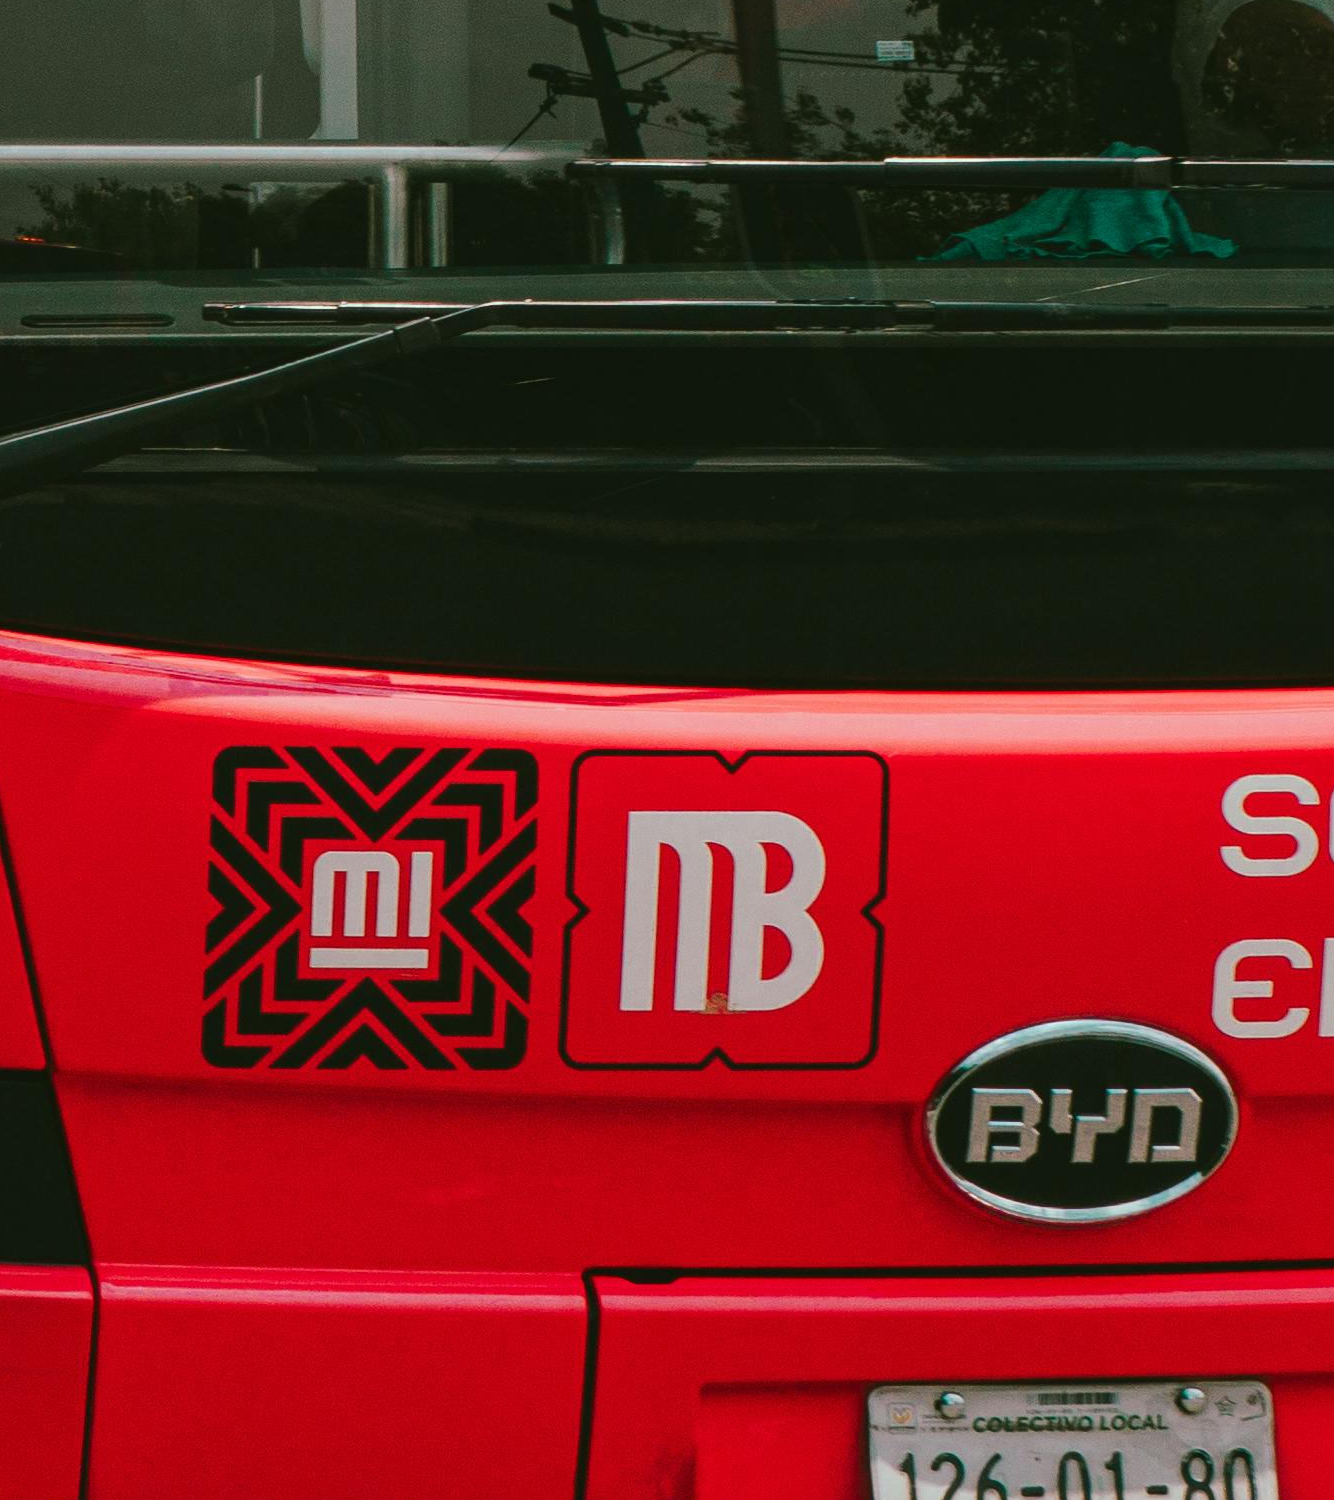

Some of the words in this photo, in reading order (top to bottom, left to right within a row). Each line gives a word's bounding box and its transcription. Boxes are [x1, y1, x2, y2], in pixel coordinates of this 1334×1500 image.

[619, 810, 827, 1012] MB
[964, 1087, 1204, 1164] BYD
[972, 1416, 1094, 1433] COLECTIVO
[1099, 1414, 1169, 1431] LOCAL
